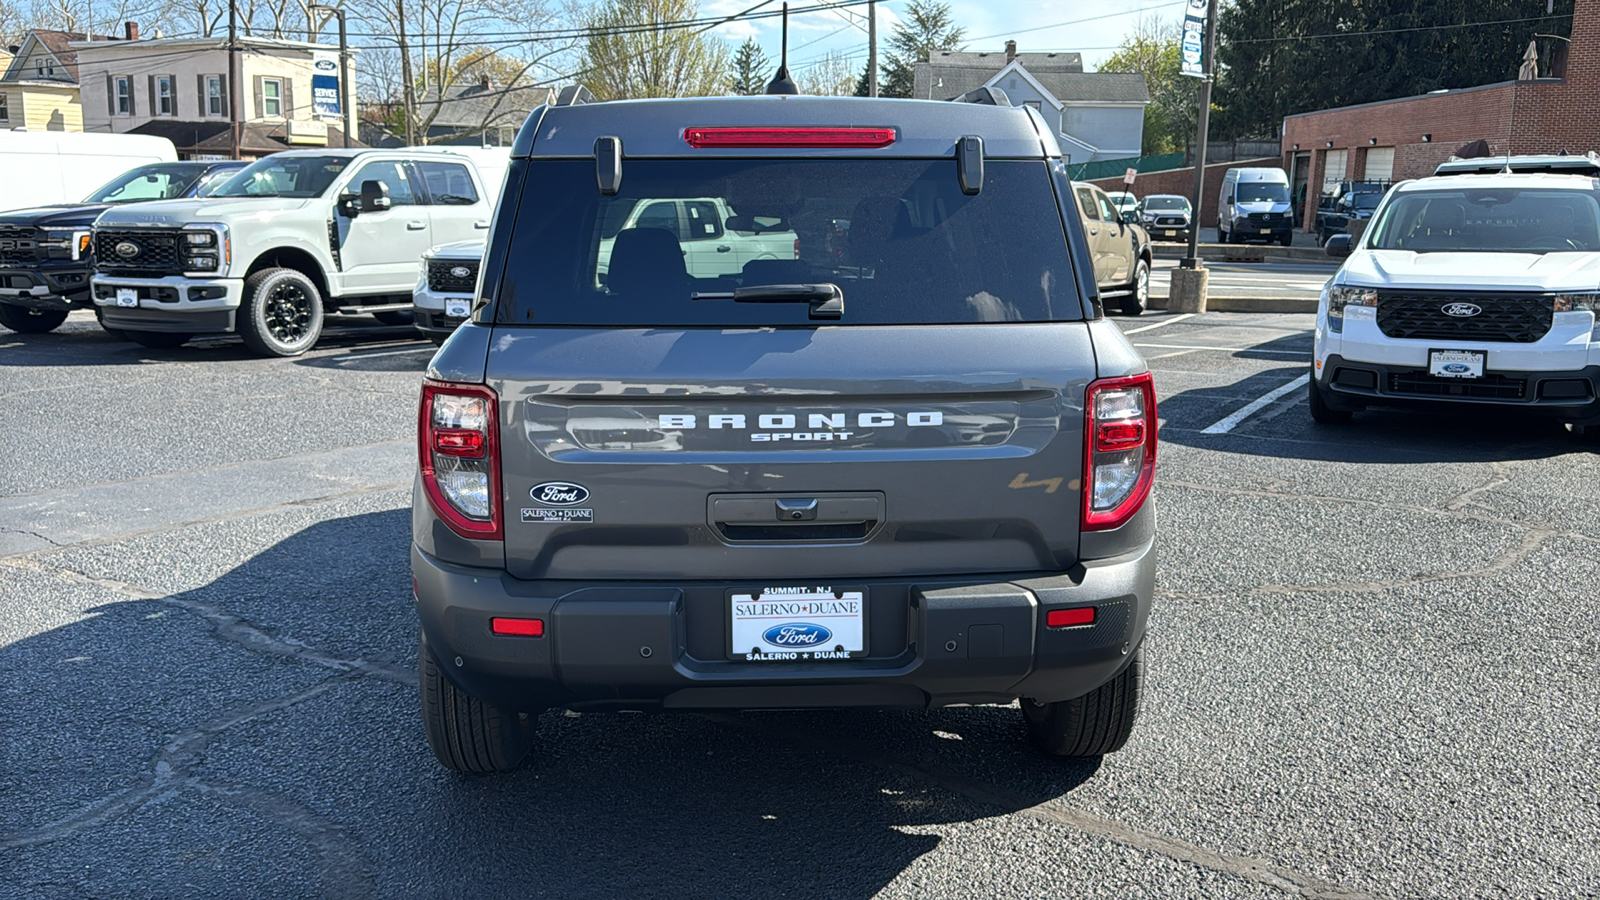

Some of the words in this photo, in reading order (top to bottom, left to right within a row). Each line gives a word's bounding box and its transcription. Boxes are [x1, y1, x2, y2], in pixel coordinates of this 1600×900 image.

[314, 87, 338, 98] SERVICE
[1448, 304, 1475, 315] Ford
[1447, 364, 1466, 372] Ford
[658, 411, 944, 430] BRONCO
[750, 432, 854, 442] SPORT
[541, 485, 578, 501] Ford
[816, 586, 832, 594] NJ
[736, 603, 800, 616] SALERNO
[809, 602, 859, 614] DUANE
[775, 626, 818, 644] Ford
[746, 652, 798, 661] SALERNO
[814, 651, 851, 659] DUANE
